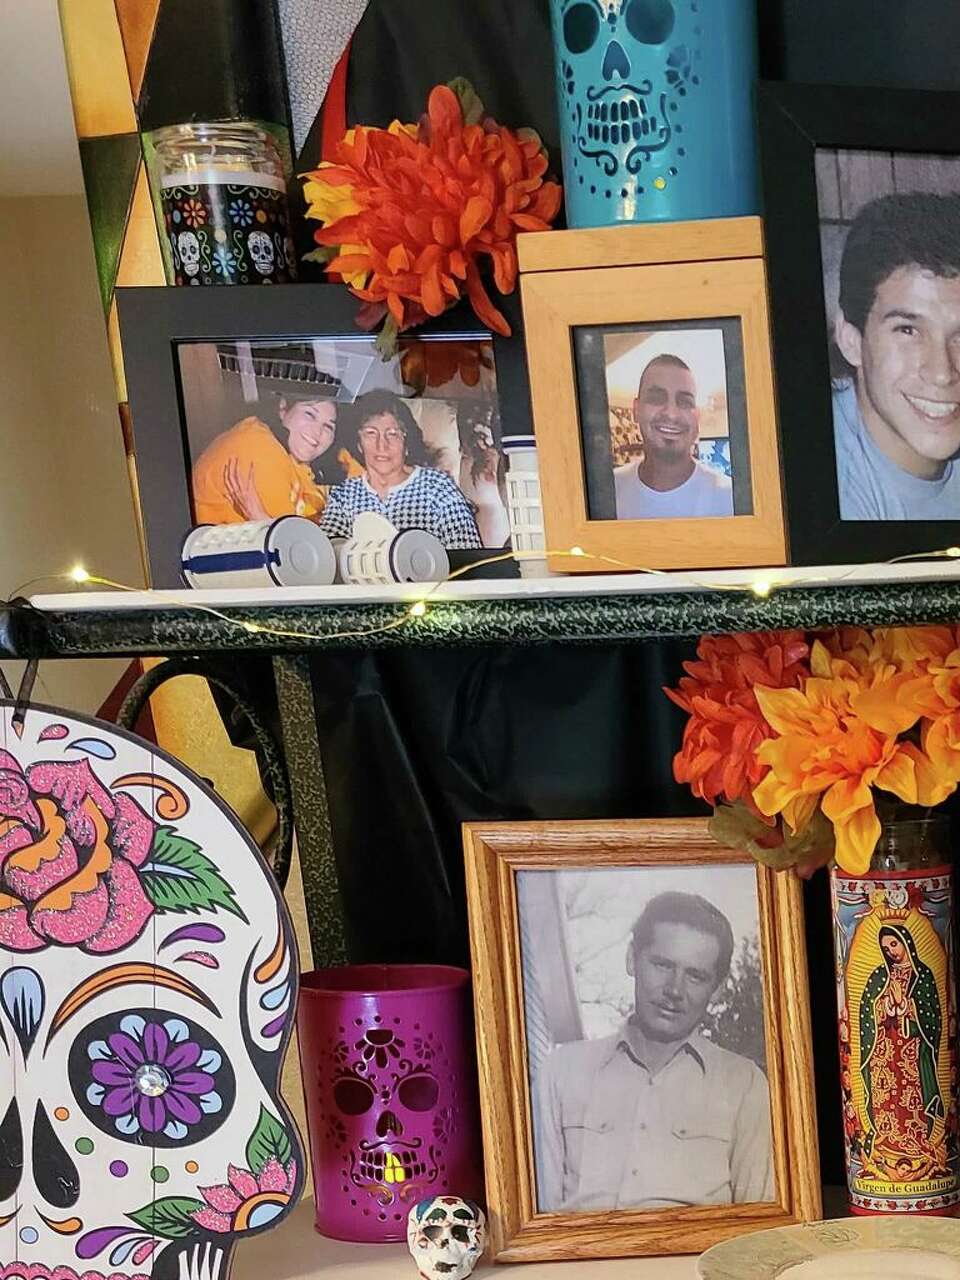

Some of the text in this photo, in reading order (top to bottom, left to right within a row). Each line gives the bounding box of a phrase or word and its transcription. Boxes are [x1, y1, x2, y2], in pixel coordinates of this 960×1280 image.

[857, 1178, 955, 1193] Virgen de Guadalupe
